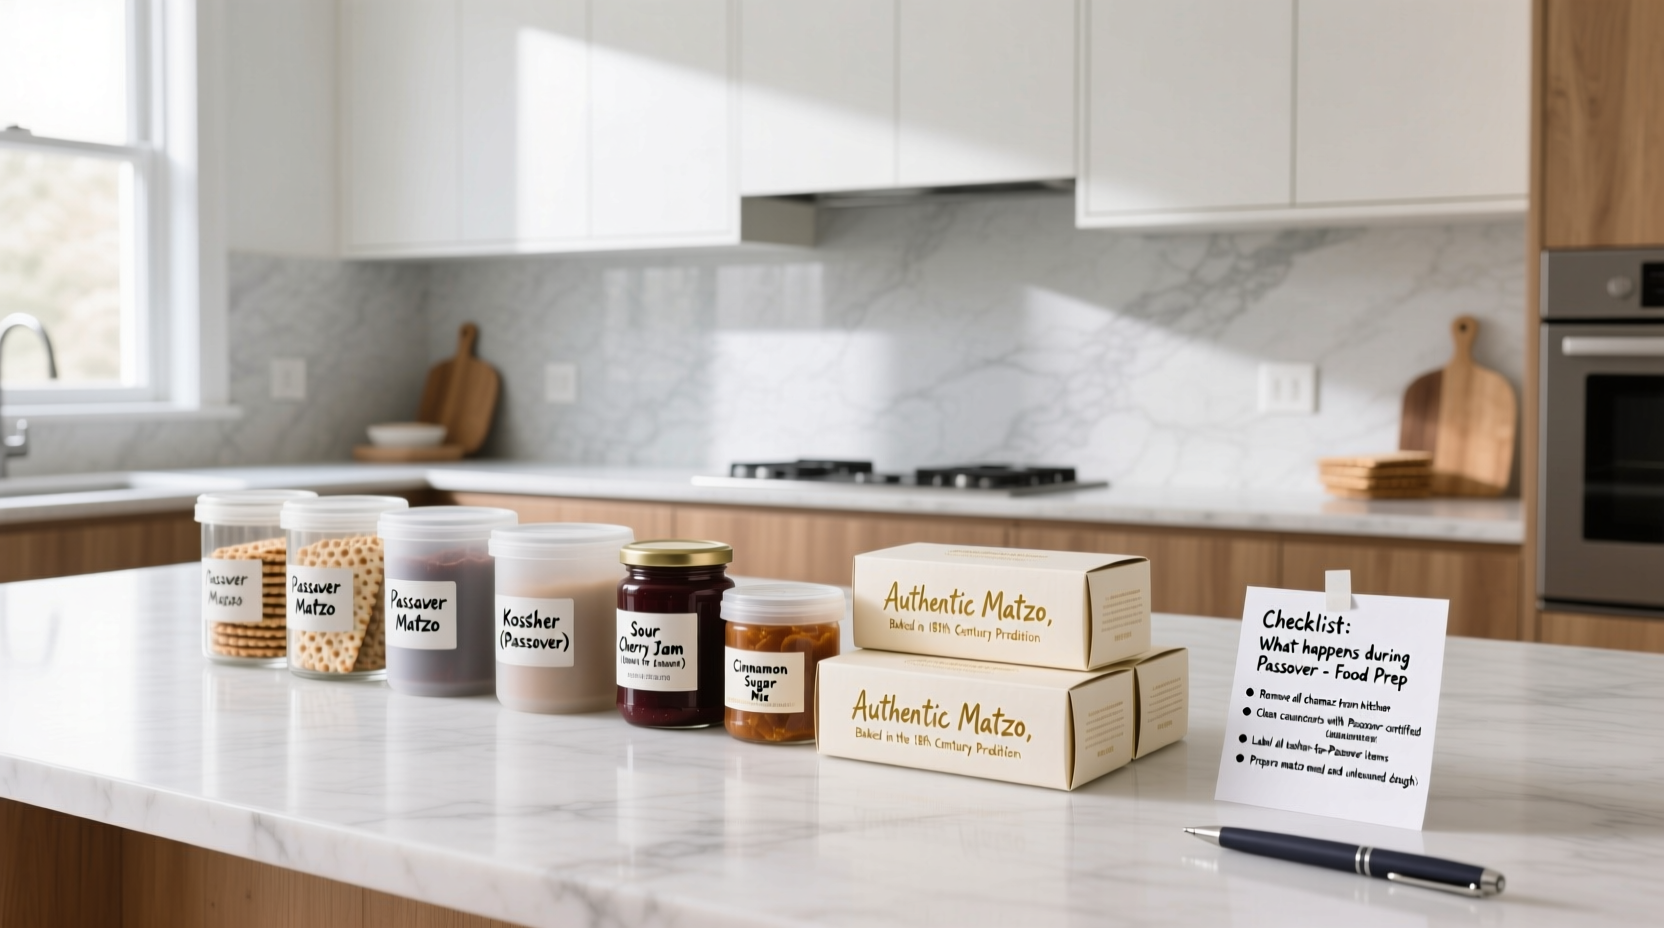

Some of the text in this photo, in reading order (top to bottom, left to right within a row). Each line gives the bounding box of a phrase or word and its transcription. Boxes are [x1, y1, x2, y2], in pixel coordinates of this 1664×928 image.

[295, 598, 336, 616] Matzo
[883, 581, 975, 617] Authentic
[981, 590, 1052, 627] Matzo,
[396, 614, 440, 632] Matzo
[503, 607, 560, 629] Kossher
[630, 620, 661, 638] Sour
[1262, 609, 1351, 635] Checklist:
[500, 630, 569, 652] (Passover)
[653, 640, 684, 656] Jam
[1260, 636, 1411, 671] What happens during
[733, 658, 788, 675] Cinnamon
[1257, 655, 1319, 677] Passover
[1335, 664, 1369, 682] Food
[1374, 667, 1408, 692] Prep
[744, 675, 777, 692] Sugar
[851, 689, 950, 729] Authentic
[957, 702, 1032, 743] Matzo,
